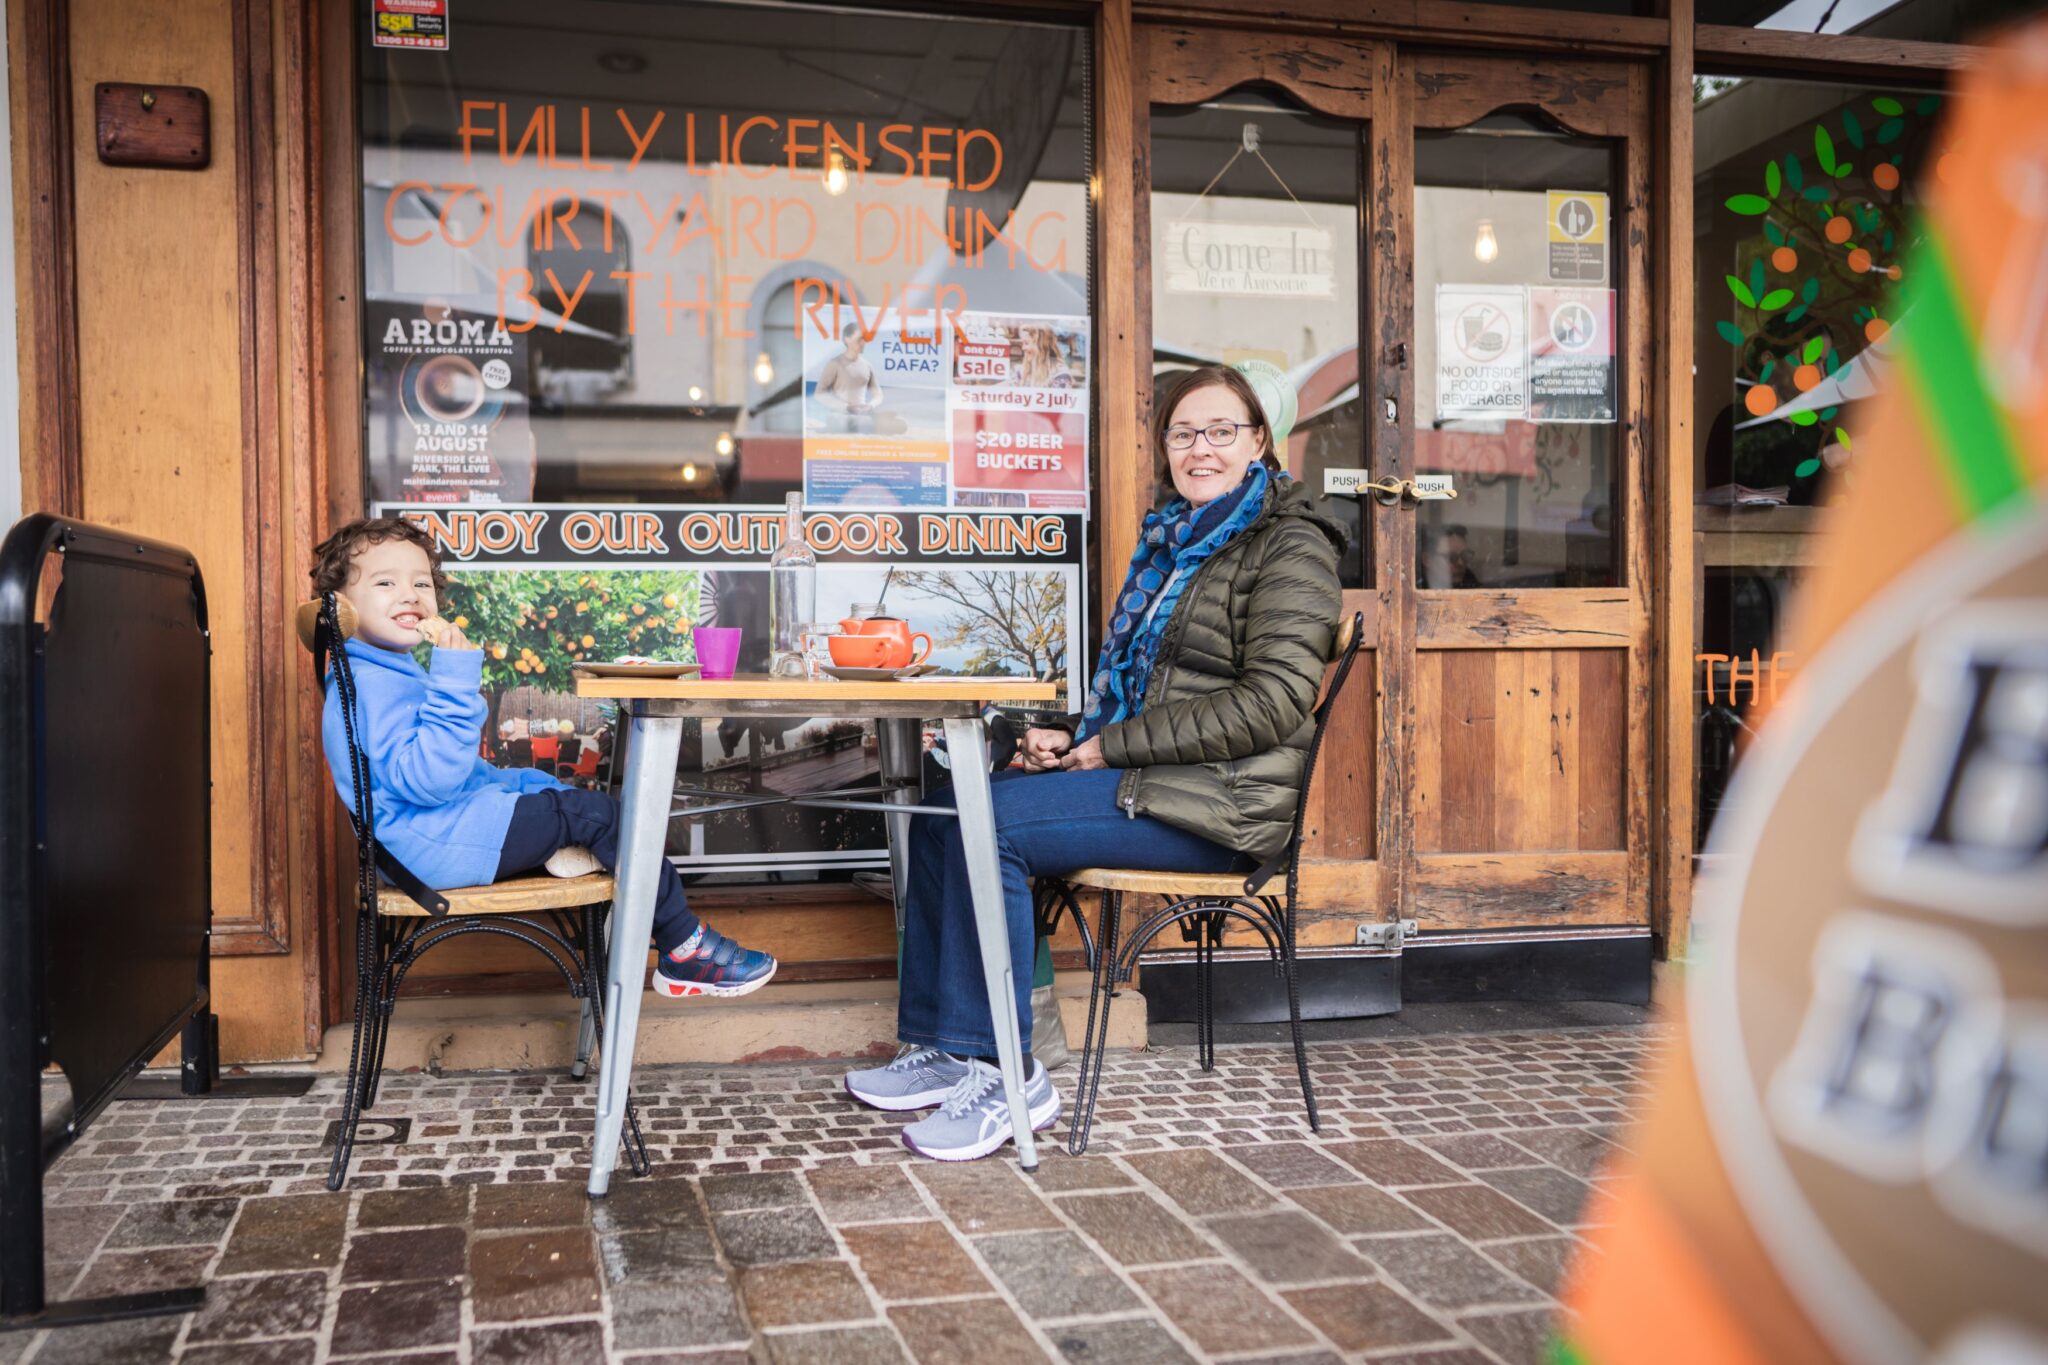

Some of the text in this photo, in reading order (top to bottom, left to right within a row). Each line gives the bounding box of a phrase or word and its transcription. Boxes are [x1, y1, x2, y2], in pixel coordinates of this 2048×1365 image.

[379, 13, 414, 31] SSM
[377, 36, 401, 45] 1300
[403, 37, 415, 46] 13
[458, 100, 1003, 192] FULLY LICENSED
[384, 181, 1067, 272] COURTYARD DINING
[1181, 226, 1319, 274] Come In
[1243, 272, 1308, 291] Awesome
[498, 268, 969, 344] BY THE RIVER
[383, 318, 513, 346] AROMA
[425, 346, 473, 354] CHOCOLATE
[476, 347, 513, 355] FESTIVAL
[882, 341, 939, 355] FALUN
[985, 346, 1005, 357] day
[489, 366, 507, 375] FREE
[884, 358, 939, 372] DAFA?
[963, 359, 1006, 376] sale
[484, 372, 508, 382] ENTRY
[1441, 366, 1521, 378] NO OUTSIDE
[1562, 369, 1593, 379] supplied
[1451, 380, 1511, 392] FOOD OR
[1535, 378, 1562, 387] anyone
[1563, 377, 1585, 385] under
[1548, 387, 1575, 396] against
[1576, 386, 1588, 394] the
[961, 390, 1077, 408] Saturday 2 July
[1442, 393, 1522, 406] BEVERAGES
[415, 423, 488, 436] 13 AND 14
[415, 436, 488, 452] AUGUST
[976, 429, 1064, 449] $20 BEER
[413, 455, 489, 464] RIVERSIDE CAR
[976, 452, 1063, 471] BUCKETS
[412, 464, 491, 474] PARK, THE LEVEE
[1332, 476, 1360, 486] PUSH
[1417, 483, 1445, 492] PUSH
[425, 493, 458, 502] events
[561, 512, 669, 555] OUR
[918, 514, 1067, 555] DINING
